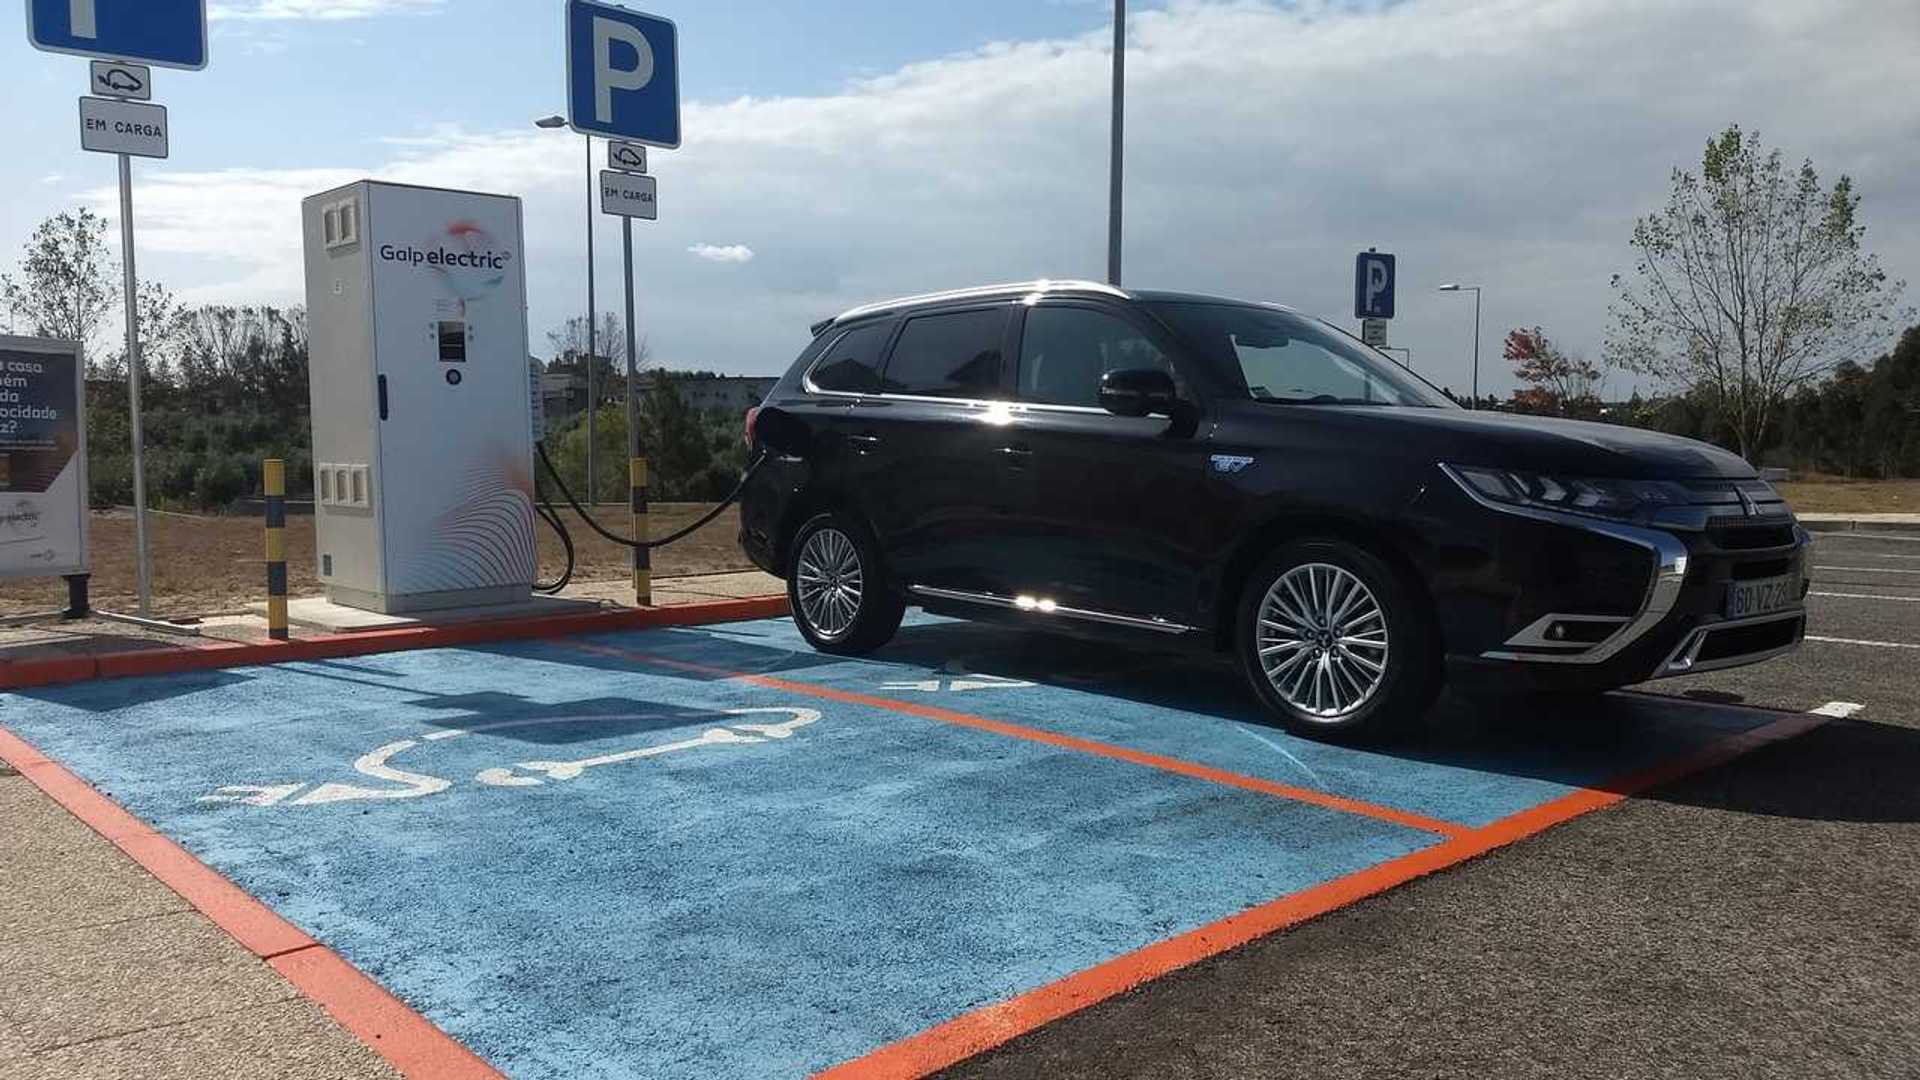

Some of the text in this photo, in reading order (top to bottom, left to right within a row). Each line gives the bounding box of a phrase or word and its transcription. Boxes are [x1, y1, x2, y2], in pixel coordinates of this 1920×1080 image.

[593, 16, 653, 123] P
[86, 118, 163, 138] EM CARGA
[604, 187, 654, 203] EM CARGA
[380, 244, 504, 270] Galp electric
[1367, 260, 1387, 311] P
[8, 361, 43, 374] casa
